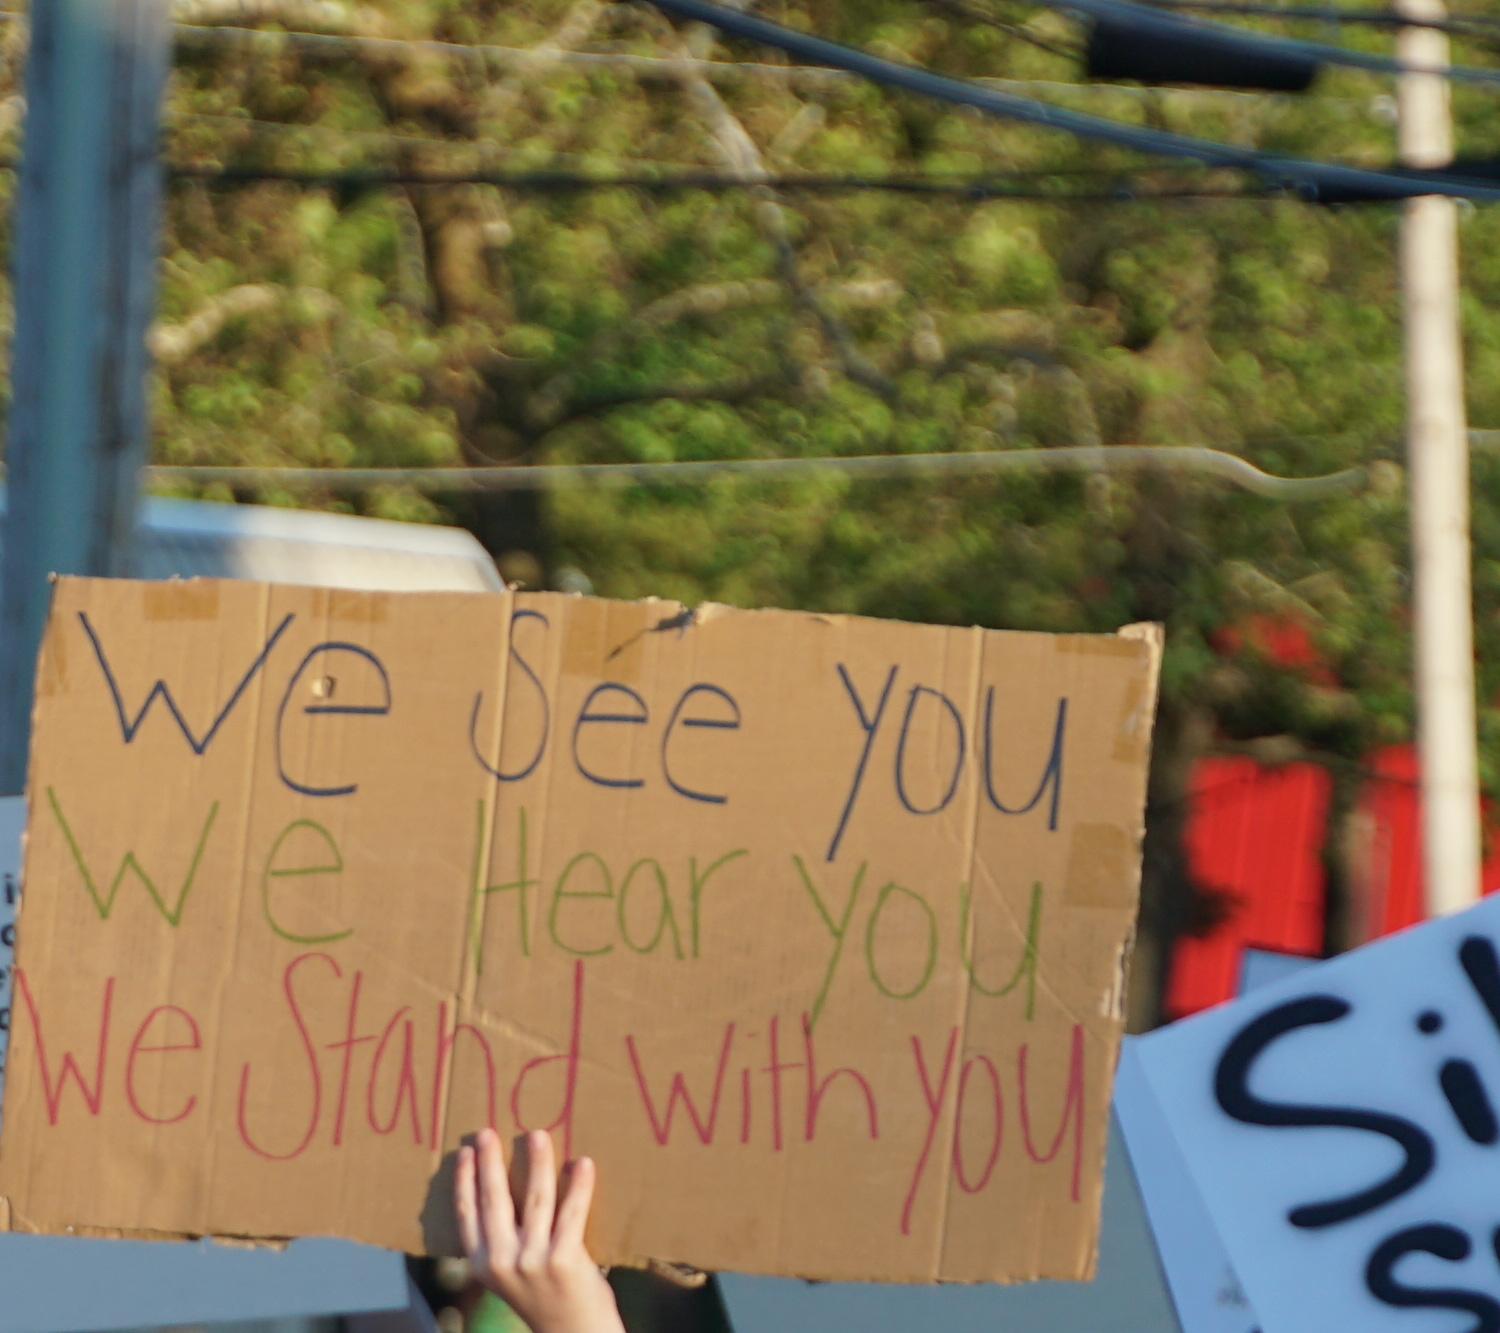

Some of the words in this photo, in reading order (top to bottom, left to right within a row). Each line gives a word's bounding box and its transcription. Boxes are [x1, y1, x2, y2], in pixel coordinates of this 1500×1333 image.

[79, 611, 391, 798] We
[470, 609, 740, 803] See
[47, 787, 353, 944] We
[14, 965, 203, 1126] We
